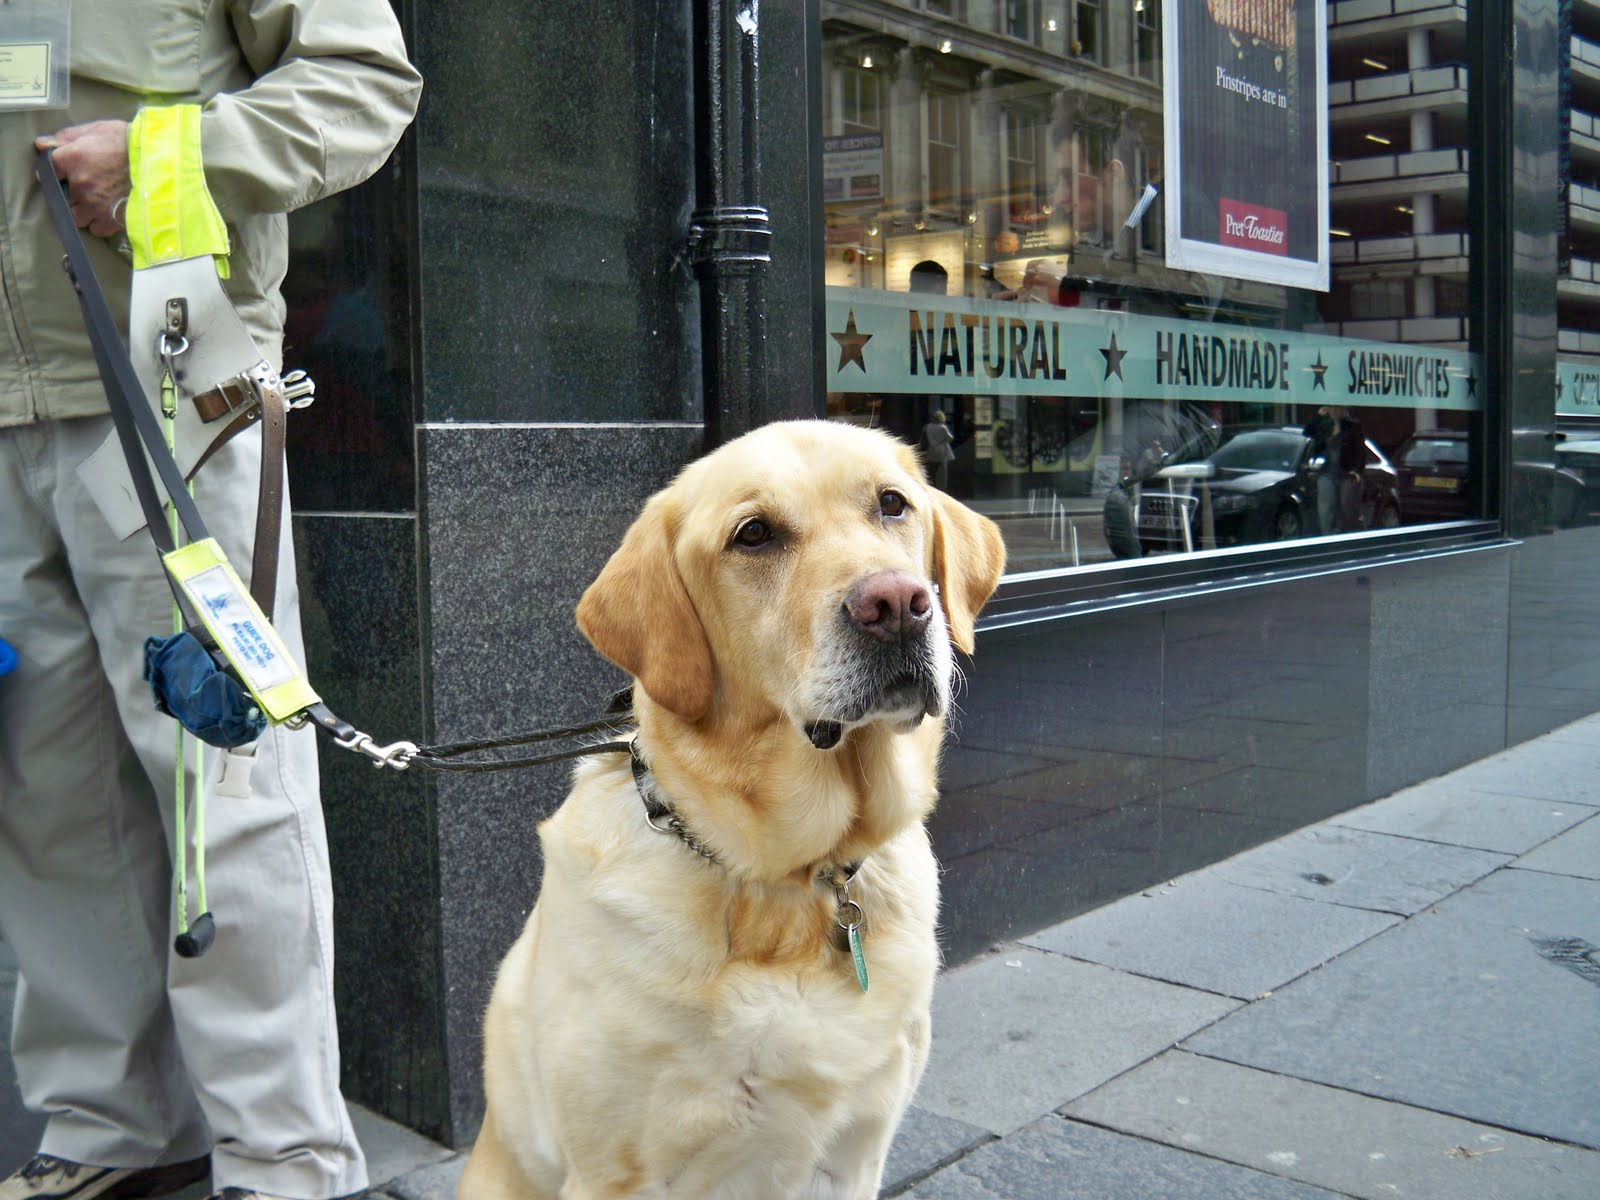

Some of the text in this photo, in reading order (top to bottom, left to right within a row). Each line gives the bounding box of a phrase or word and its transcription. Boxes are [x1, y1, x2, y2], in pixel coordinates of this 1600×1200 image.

[1216, 66, 1287, 109] Pinstripes are in
[1226, 213, 1284, 244] Pret Toasties
[909, 309, 1450, 398] NATURAL HANDMADE SANDWICHES
[243, 621, 274, 660] GUIDE DOG
